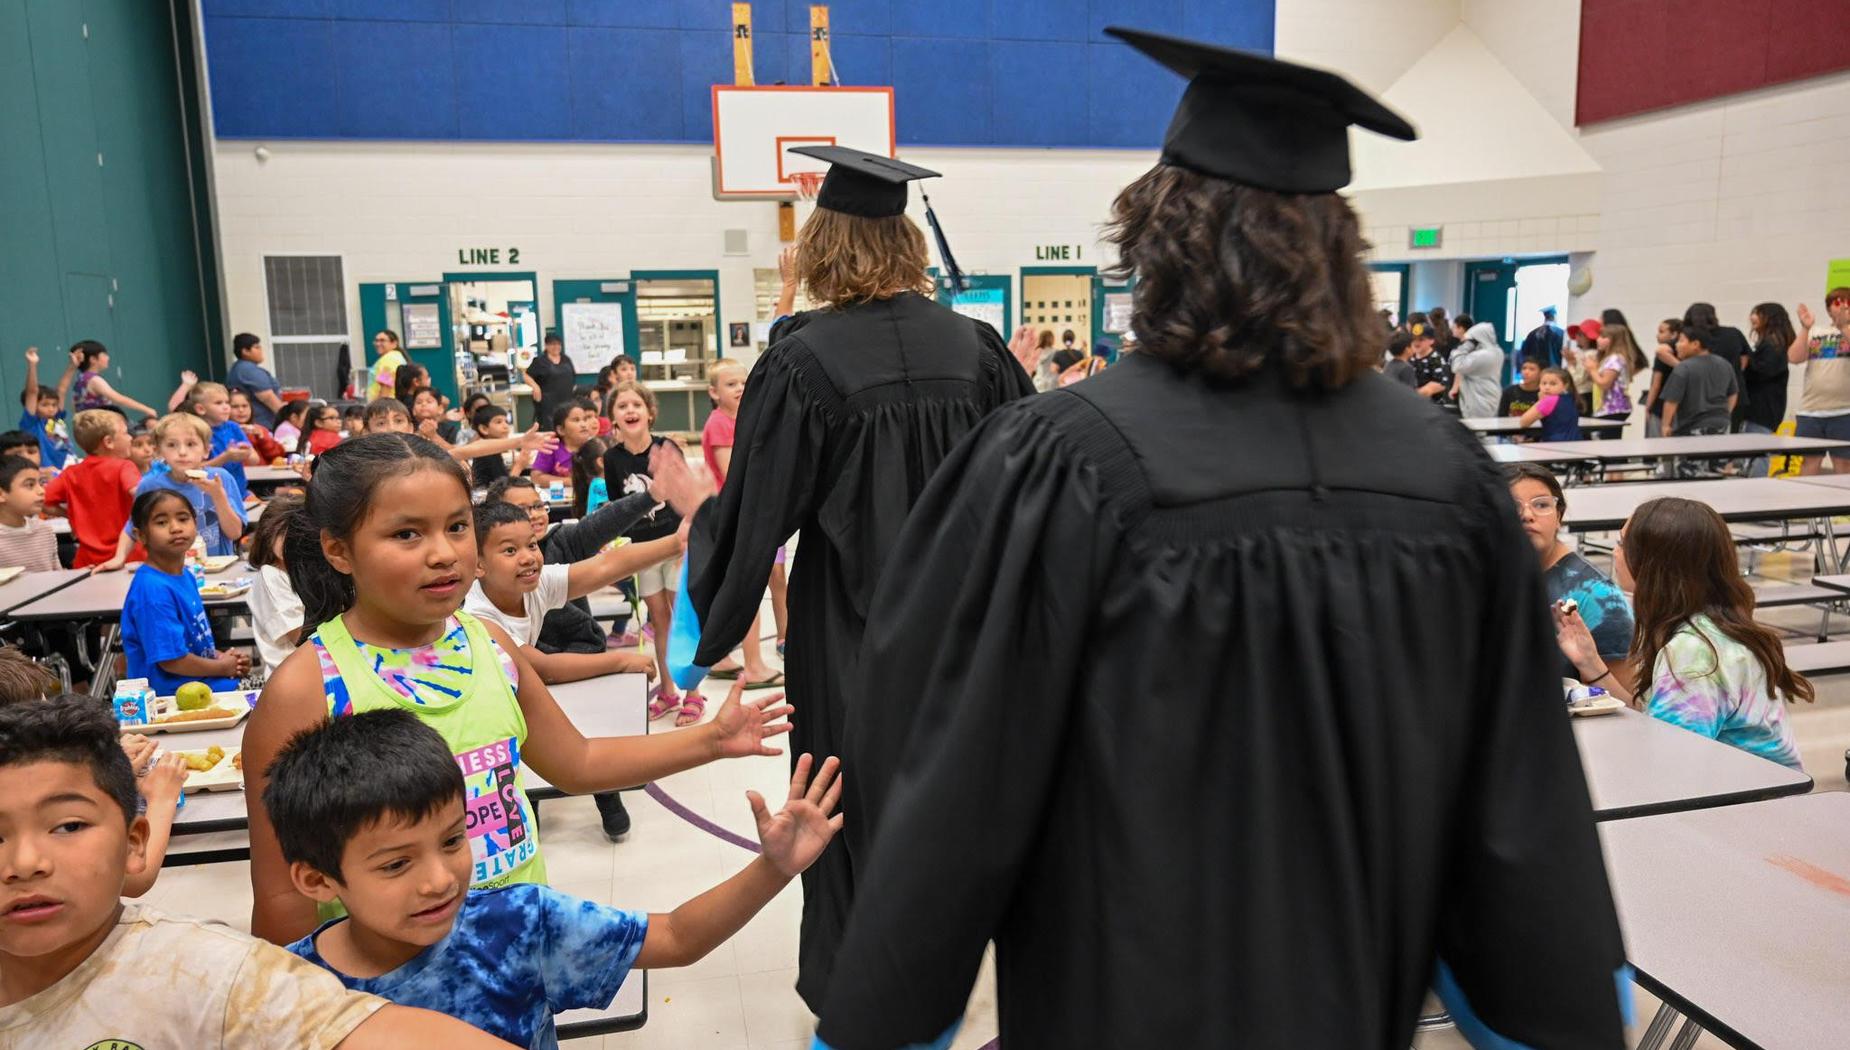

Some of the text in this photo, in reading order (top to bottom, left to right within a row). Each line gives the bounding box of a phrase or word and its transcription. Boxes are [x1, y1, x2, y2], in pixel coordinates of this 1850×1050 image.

[458, 248, 520, 265] LINE 2
[1036, 245, 1070, 260] LINE
[466, 802, 503, 830] OPE
[497, 768, 523, 840] LOVE
[476, 840, 534, 881] GRATE
